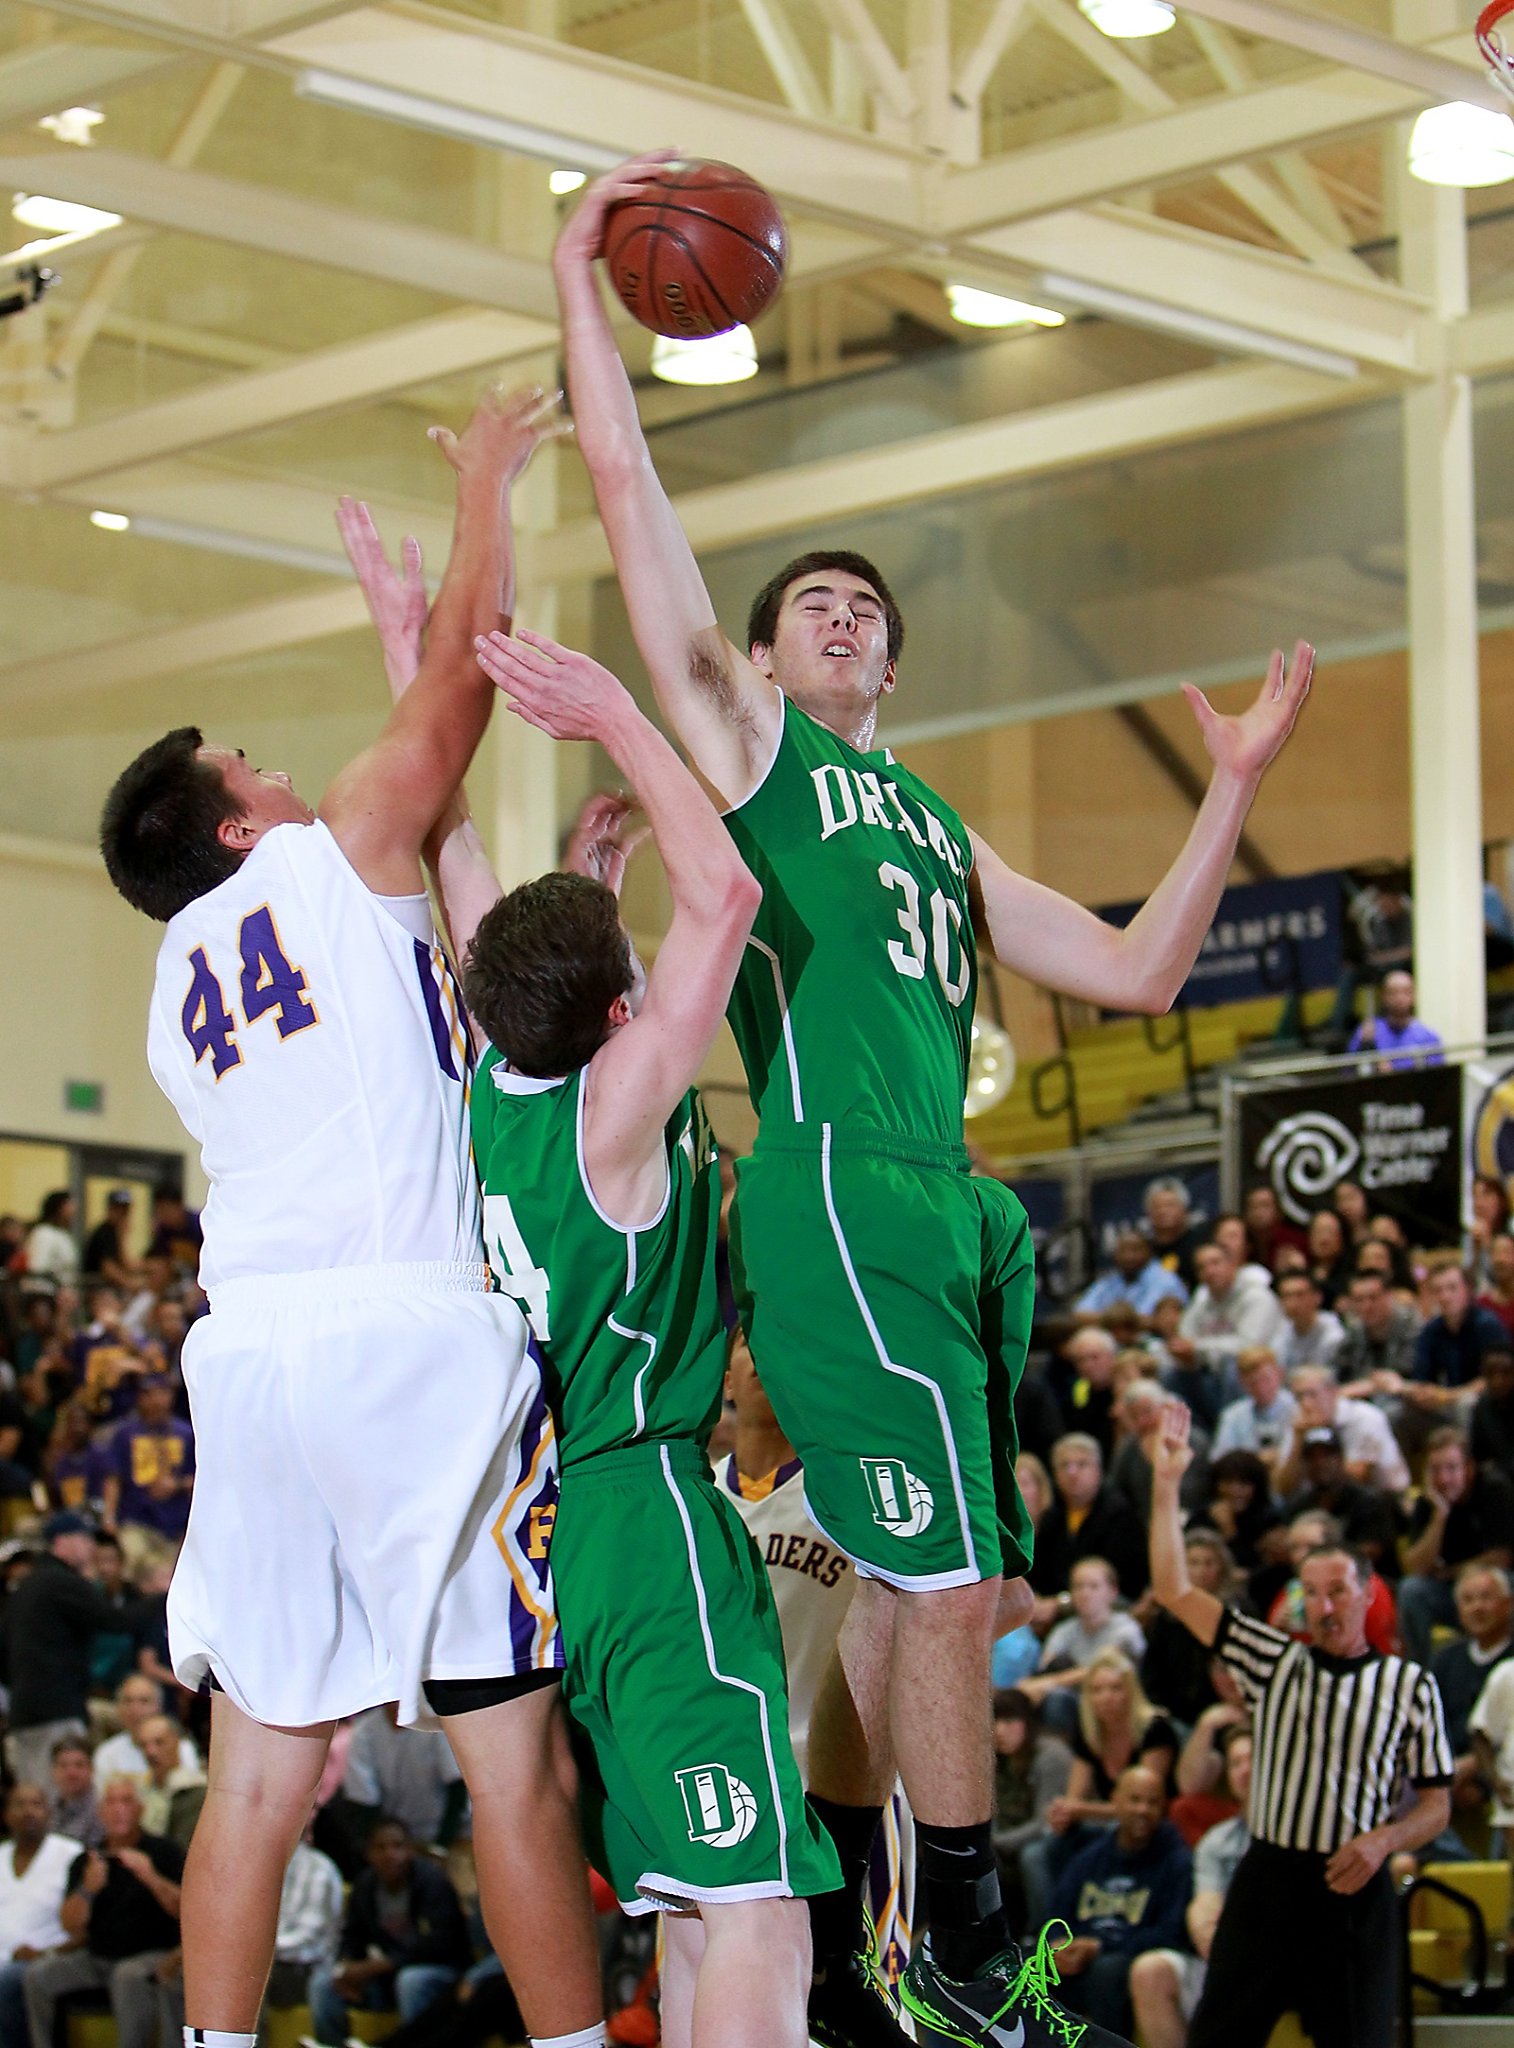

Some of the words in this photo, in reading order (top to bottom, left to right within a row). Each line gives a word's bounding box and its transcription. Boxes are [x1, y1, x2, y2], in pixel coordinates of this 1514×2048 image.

[181, 901, 321, 1085] 44
[878, 861, 970, 1007] 30
[752, 1533, 848, 1589] DERS
